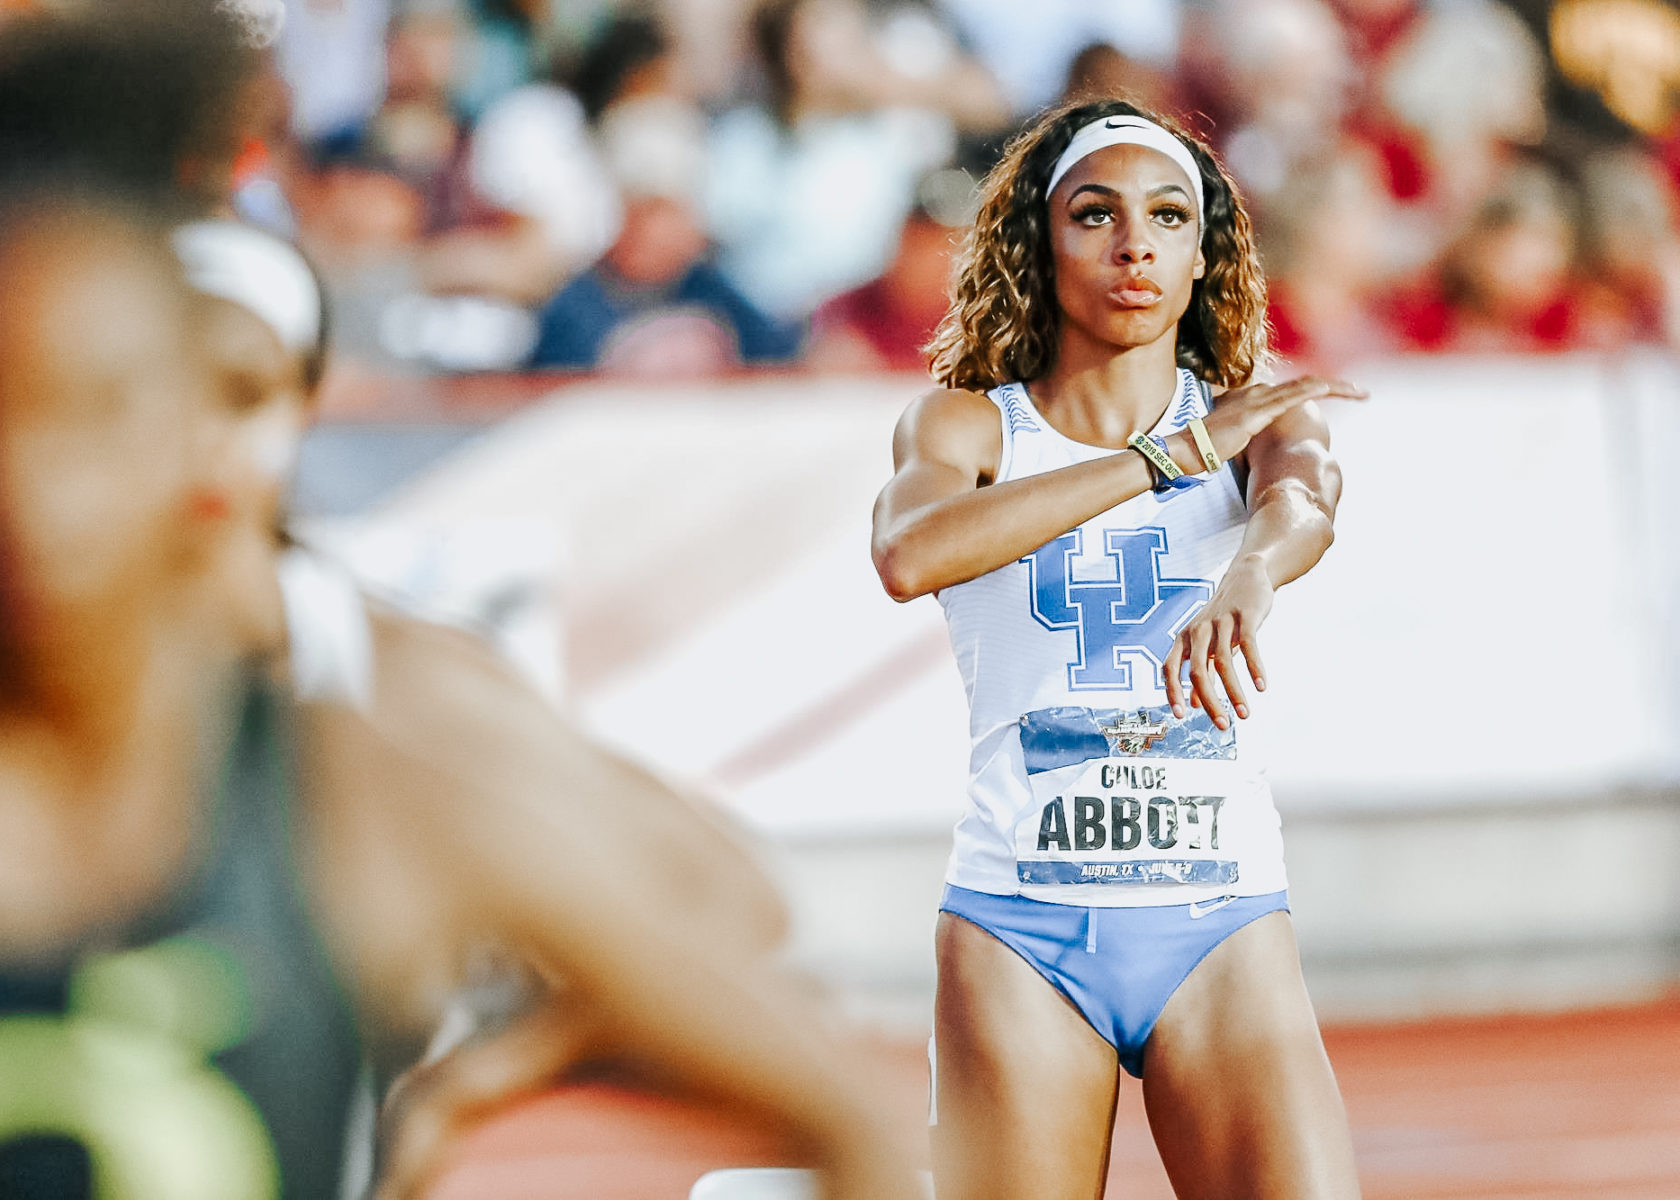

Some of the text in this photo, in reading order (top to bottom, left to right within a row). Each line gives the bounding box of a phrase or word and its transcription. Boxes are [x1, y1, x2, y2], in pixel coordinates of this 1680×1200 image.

[1142, 441, 1157, 455] 2019
[1154, 452, 1168, 466] SEC
[1101, 764, 1168, 790] CHLOE
[1036, 796, 1227, 851] ABBOTT
[1081, 864, 1118, 877] AUSTIN,
[1121, 864, 1134, 876] TX
